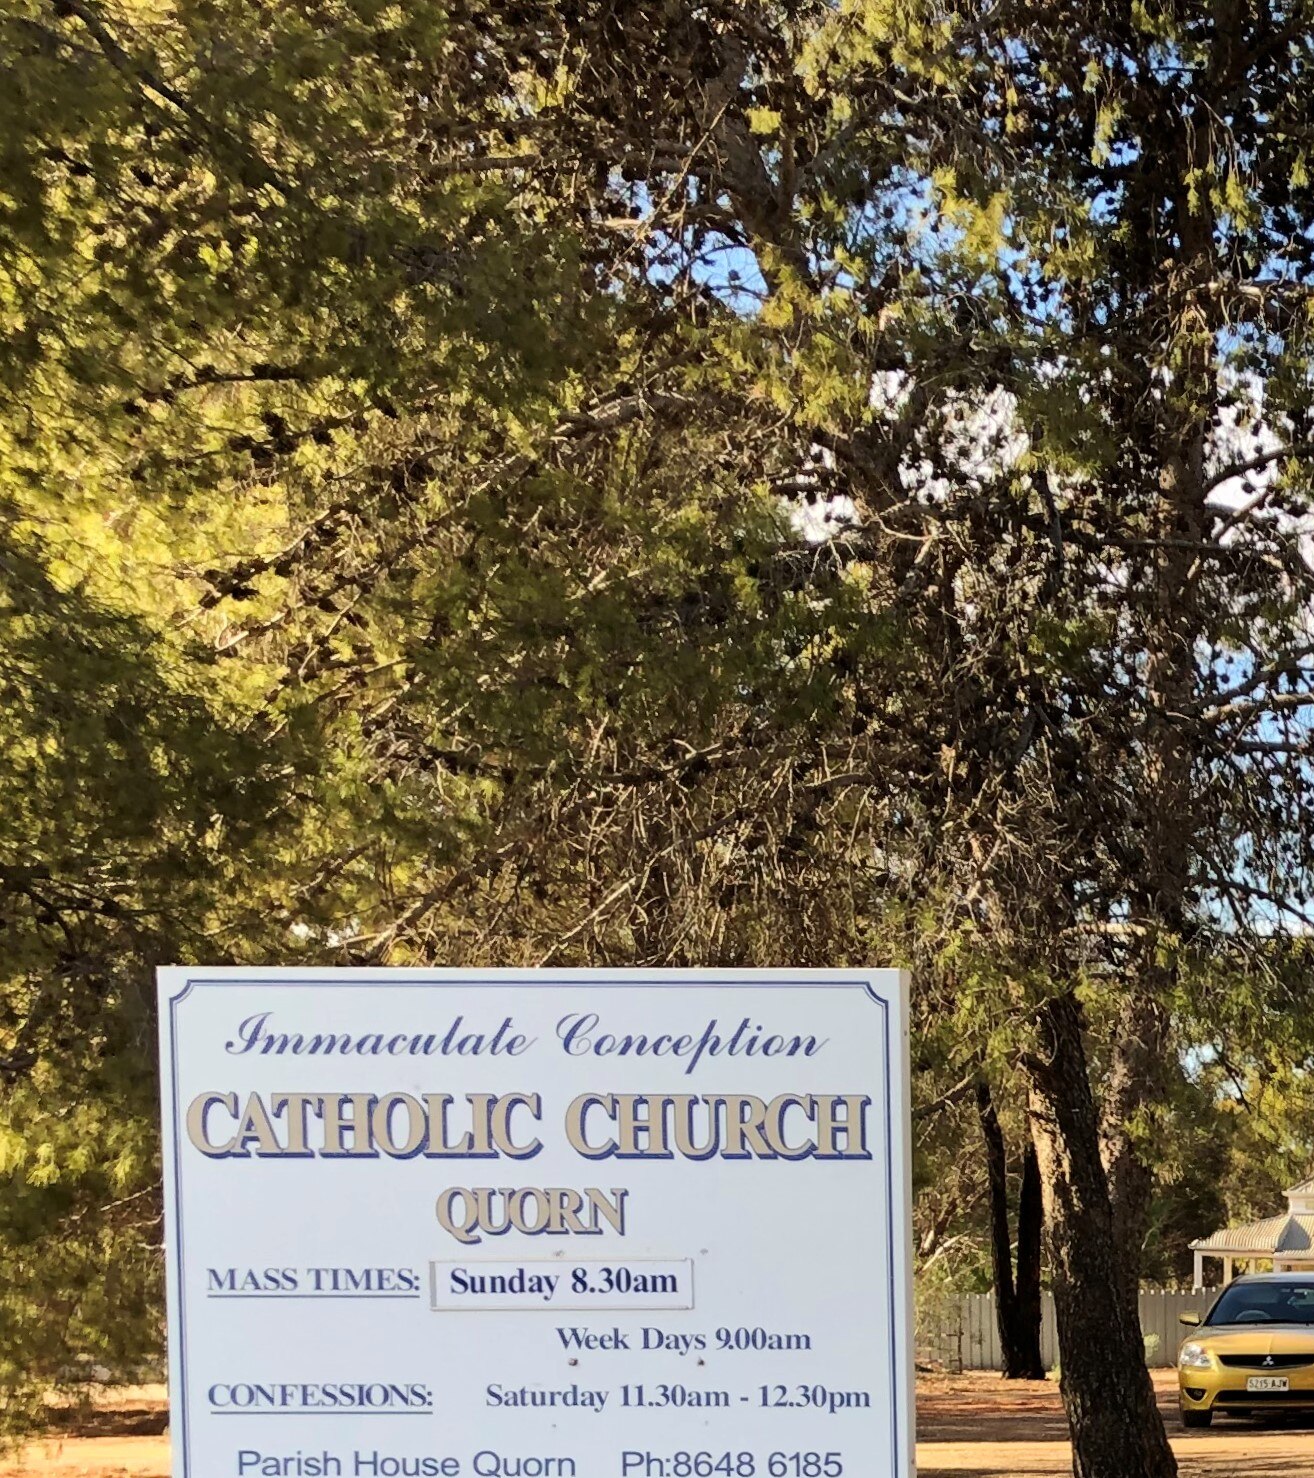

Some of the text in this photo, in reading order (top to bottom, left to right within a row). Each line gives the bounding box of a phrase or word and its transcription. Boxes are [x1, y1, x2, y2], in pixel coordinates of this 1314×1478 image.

[225, 1011, 830, 1075] Immaculate Conception
[186, 1091, 873, 1161] CATHOLIC CHURCH
[435, 1186, 629, 1245] QUORN
[206, 1267, 679, 1301] MASS TIMES: Sunday 8.30am
[556, 1326, 813, 1356] Week Days 9.00am
[207, 1383, 434, 1408] CONFESSIONS:
[485, 1383, 610, 1413] Saturday
[619, 1383, 731, 1408] 11.30am
[757, 1384, 872, 1414] 12.30pm
[237, 1450, 844, 1478] Parish House Quorn Ph:8648 6185
